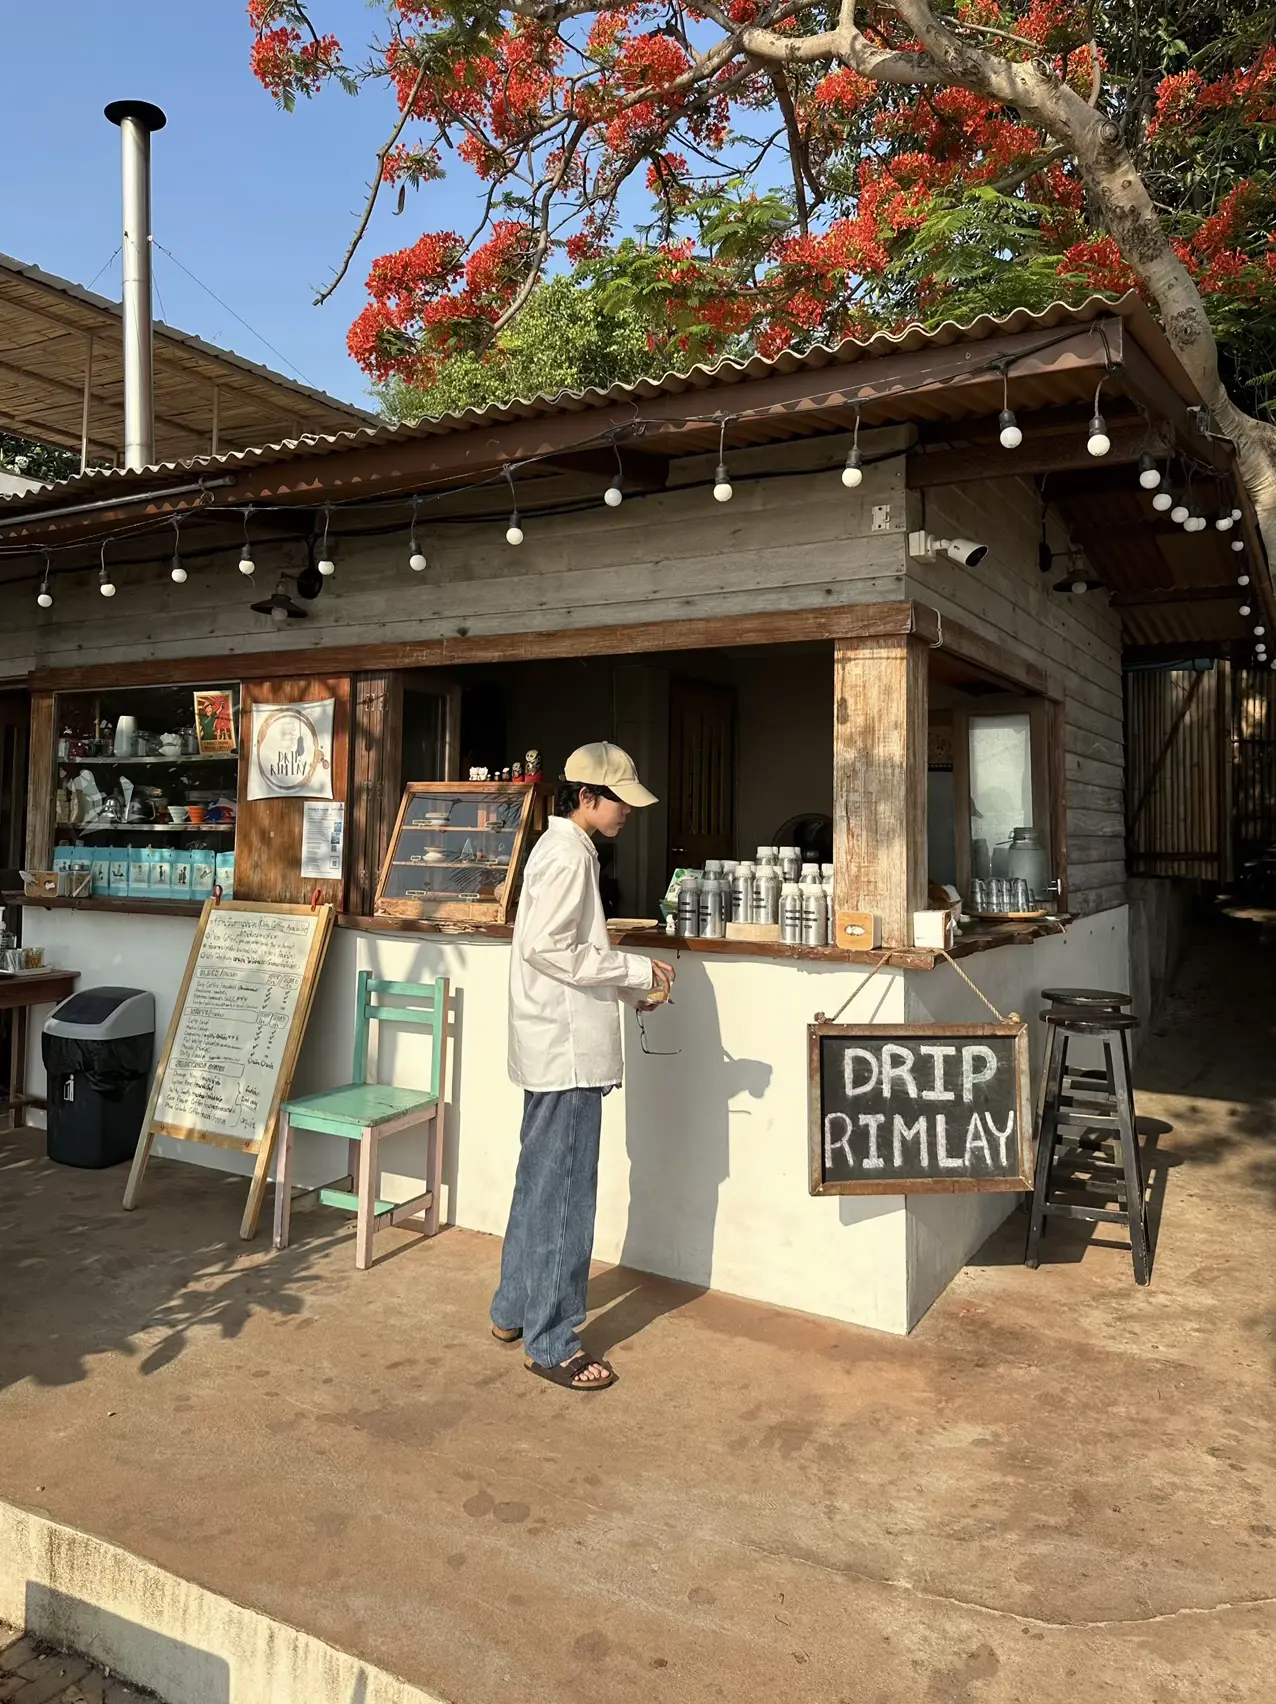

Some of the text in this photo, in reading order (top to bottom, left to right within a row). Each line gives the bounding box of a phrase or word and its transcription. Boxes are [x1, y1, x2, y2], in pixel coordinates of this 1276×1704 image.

[270, 760, 307, 776] RIMLAY
[278, 750, 300, 764] DRIP
[844, 1043, 997, 1102] DRIP
[824, 1110, 1014, 1169] RIMLAY
